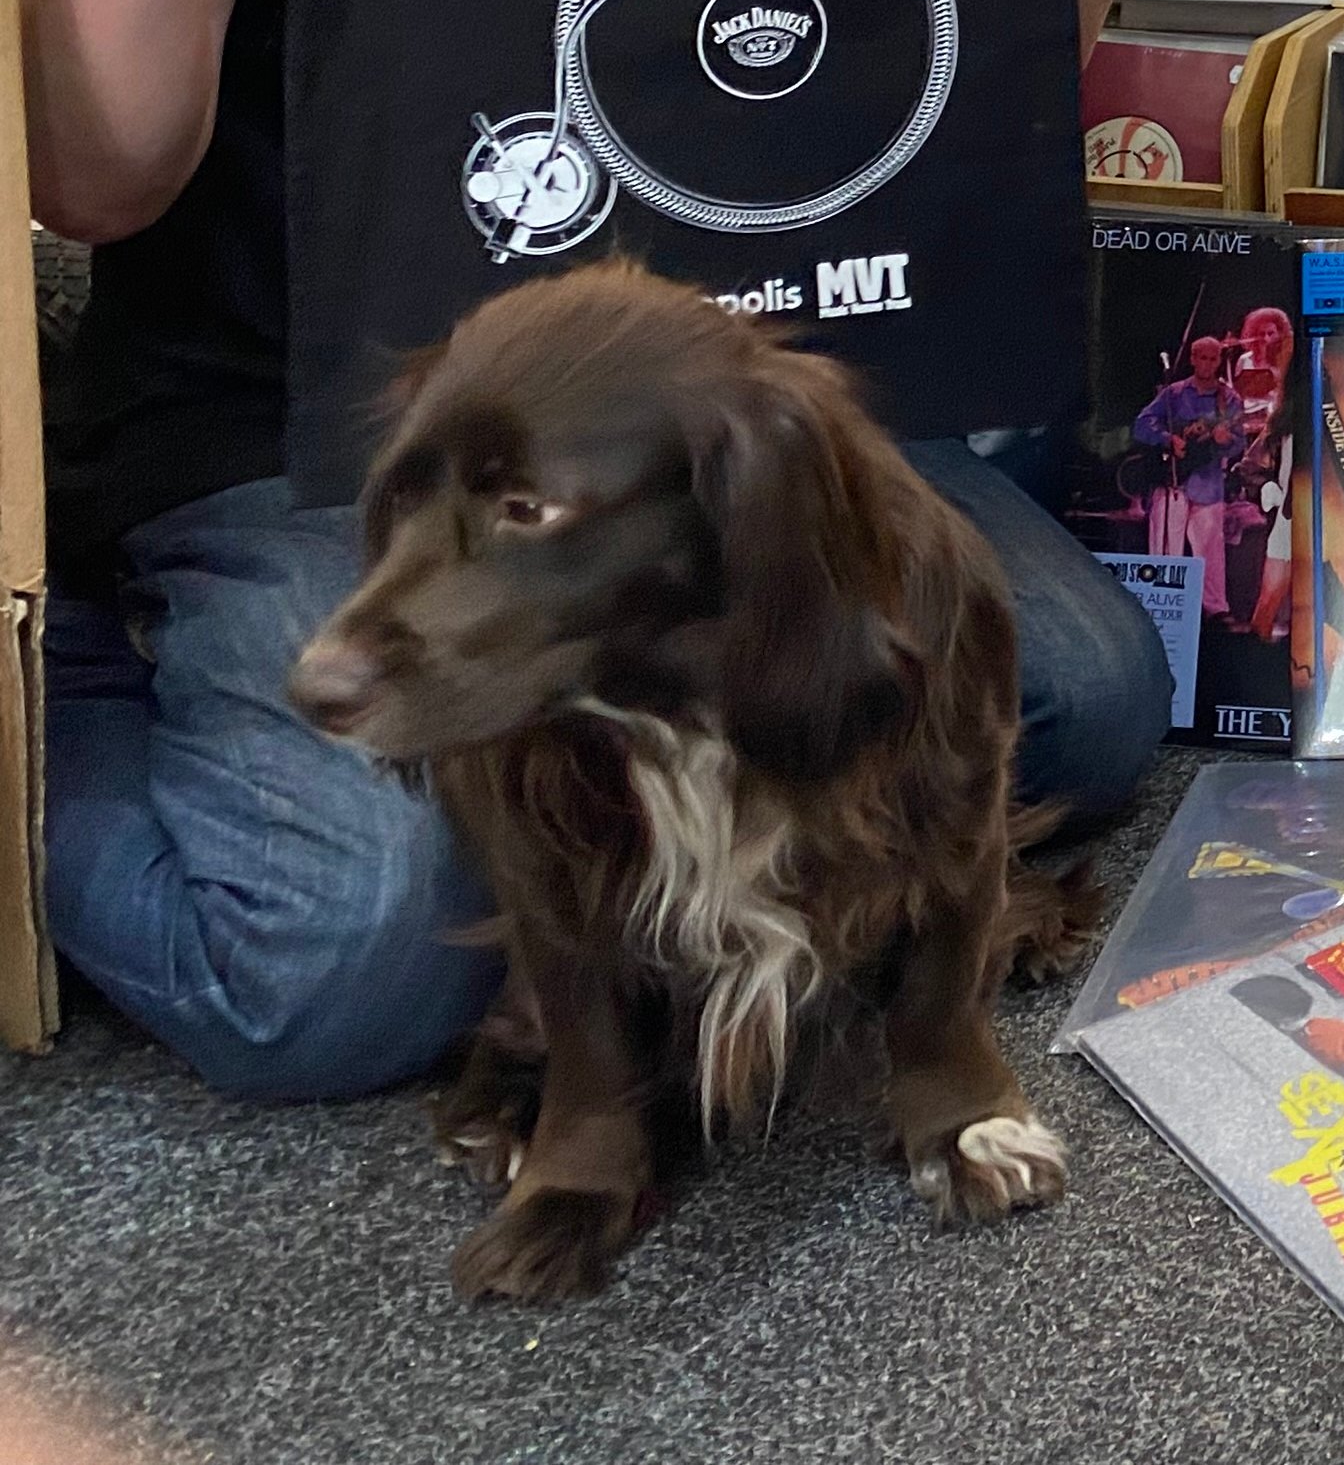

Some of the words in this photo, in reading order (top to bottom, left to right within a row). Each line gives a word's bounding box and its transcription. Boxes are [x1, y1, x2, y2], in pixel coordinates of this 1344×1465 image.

[711, 11, 753, 45] JACK
[1092, 228, 1151, 250] DEAD
[1155, 231, 1188, 252] OR
[1191, 232, 1252, 255] ALIVE
[702, 278, 804, 316] polis
[816, 253, 910, 308] MVT
[1146, 593, 1186, 608] ALIVE
[1215, 709, 1264, 735] THE
